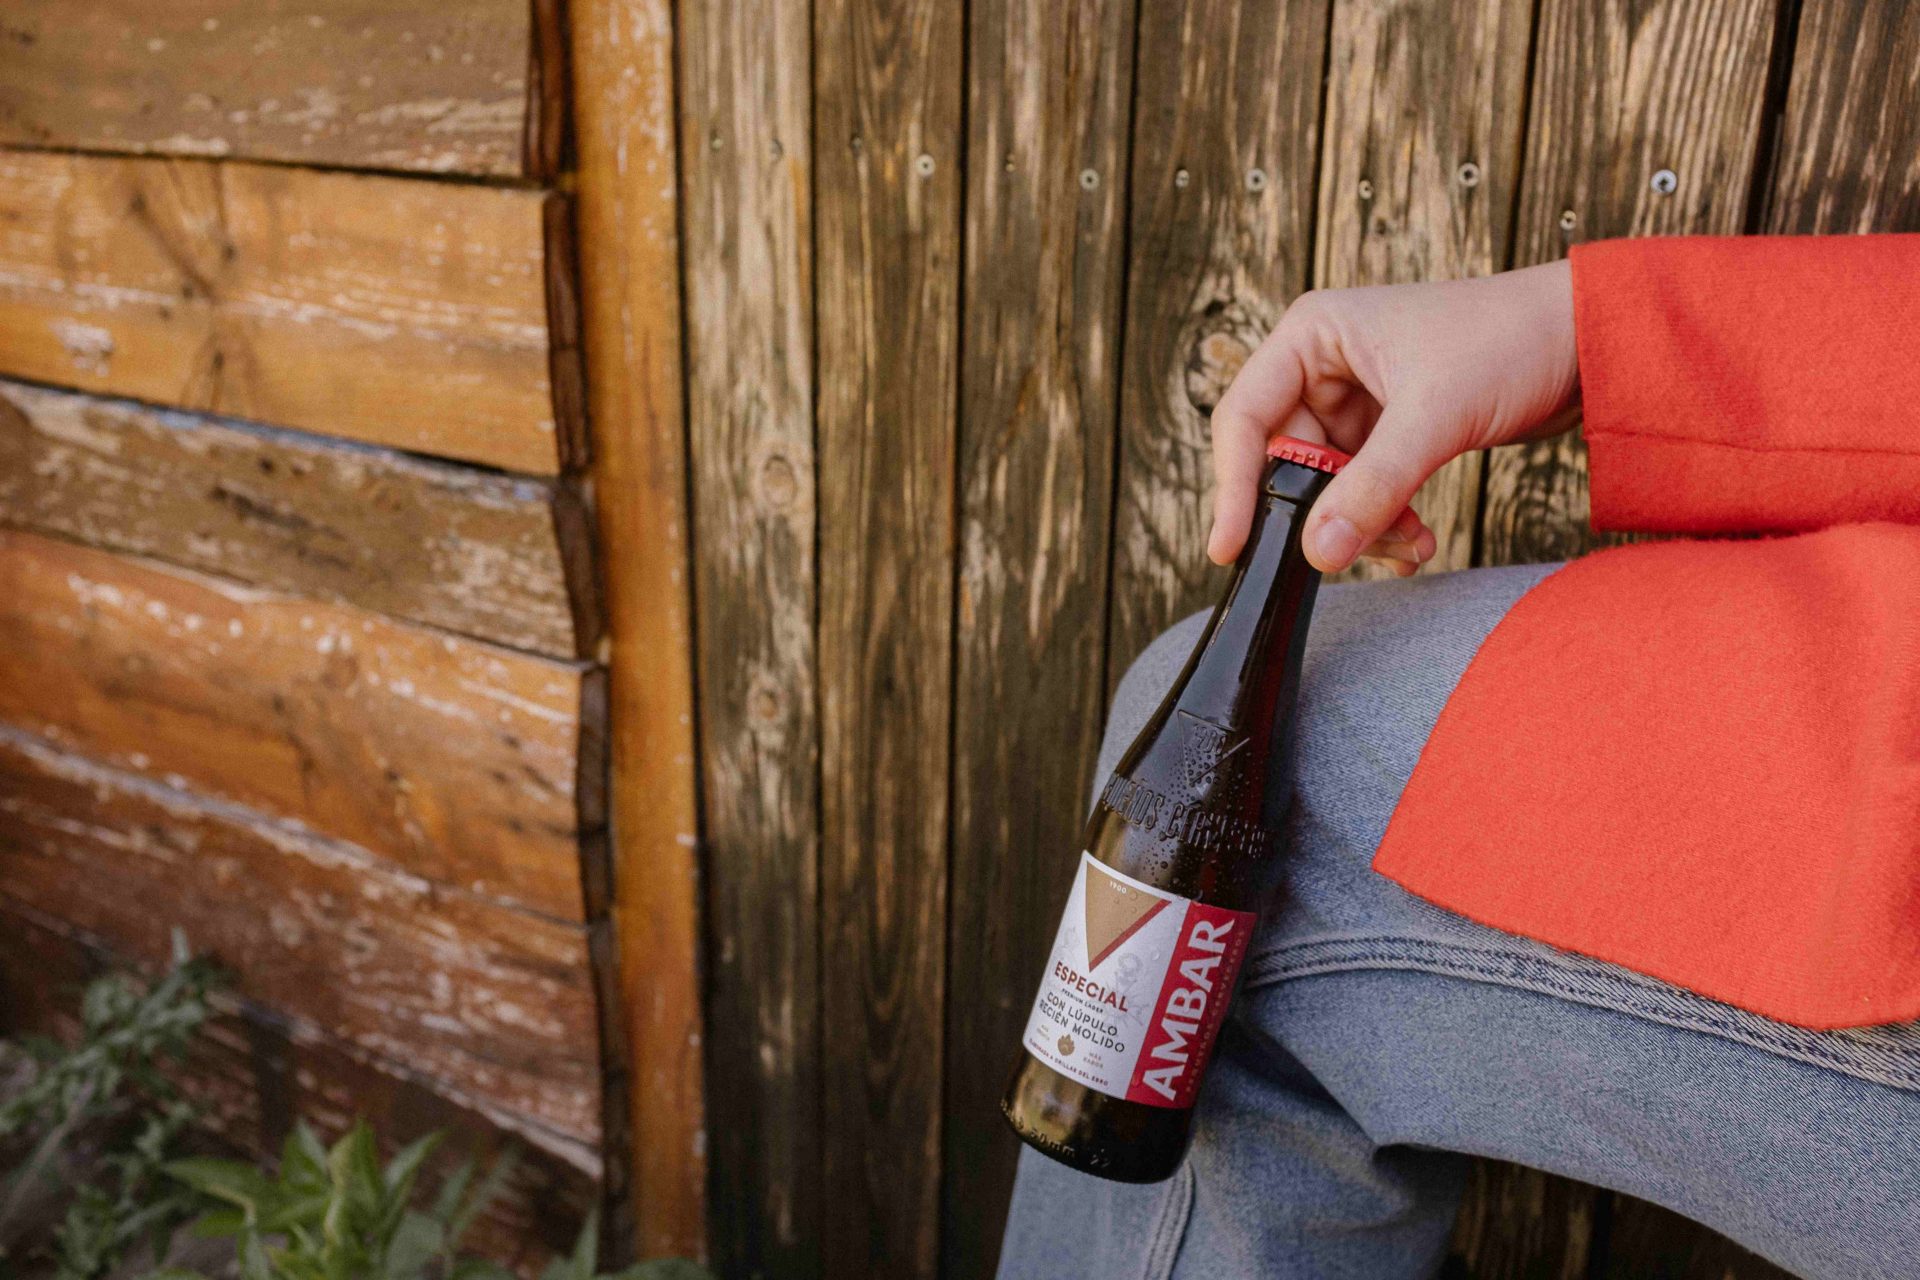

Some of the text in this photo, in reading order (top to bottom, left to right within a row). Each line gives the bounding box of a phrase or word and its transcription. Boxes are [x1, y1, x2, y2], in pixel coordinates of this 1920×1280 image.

[1109, 881, 1127, 894] 1900
[1054, 961, 1128, 1012] ESPECIAL
[1061, 988, 1103, 1014] PREMIUM LAGER
[1039, 999, 1069, 1028] RECIÉN
[1072, 1023, 1125, 1053] MOLIDO
[1047, 991, 1066, 1010] CON
[1068, 1006, 1118, 1036] LÚPULO
[1142, 919, 1235, 1101] AMBAR
[1078, 1070, 1089, 1079] DEL
[1091, 1075, 1108, 1087] EBRO
